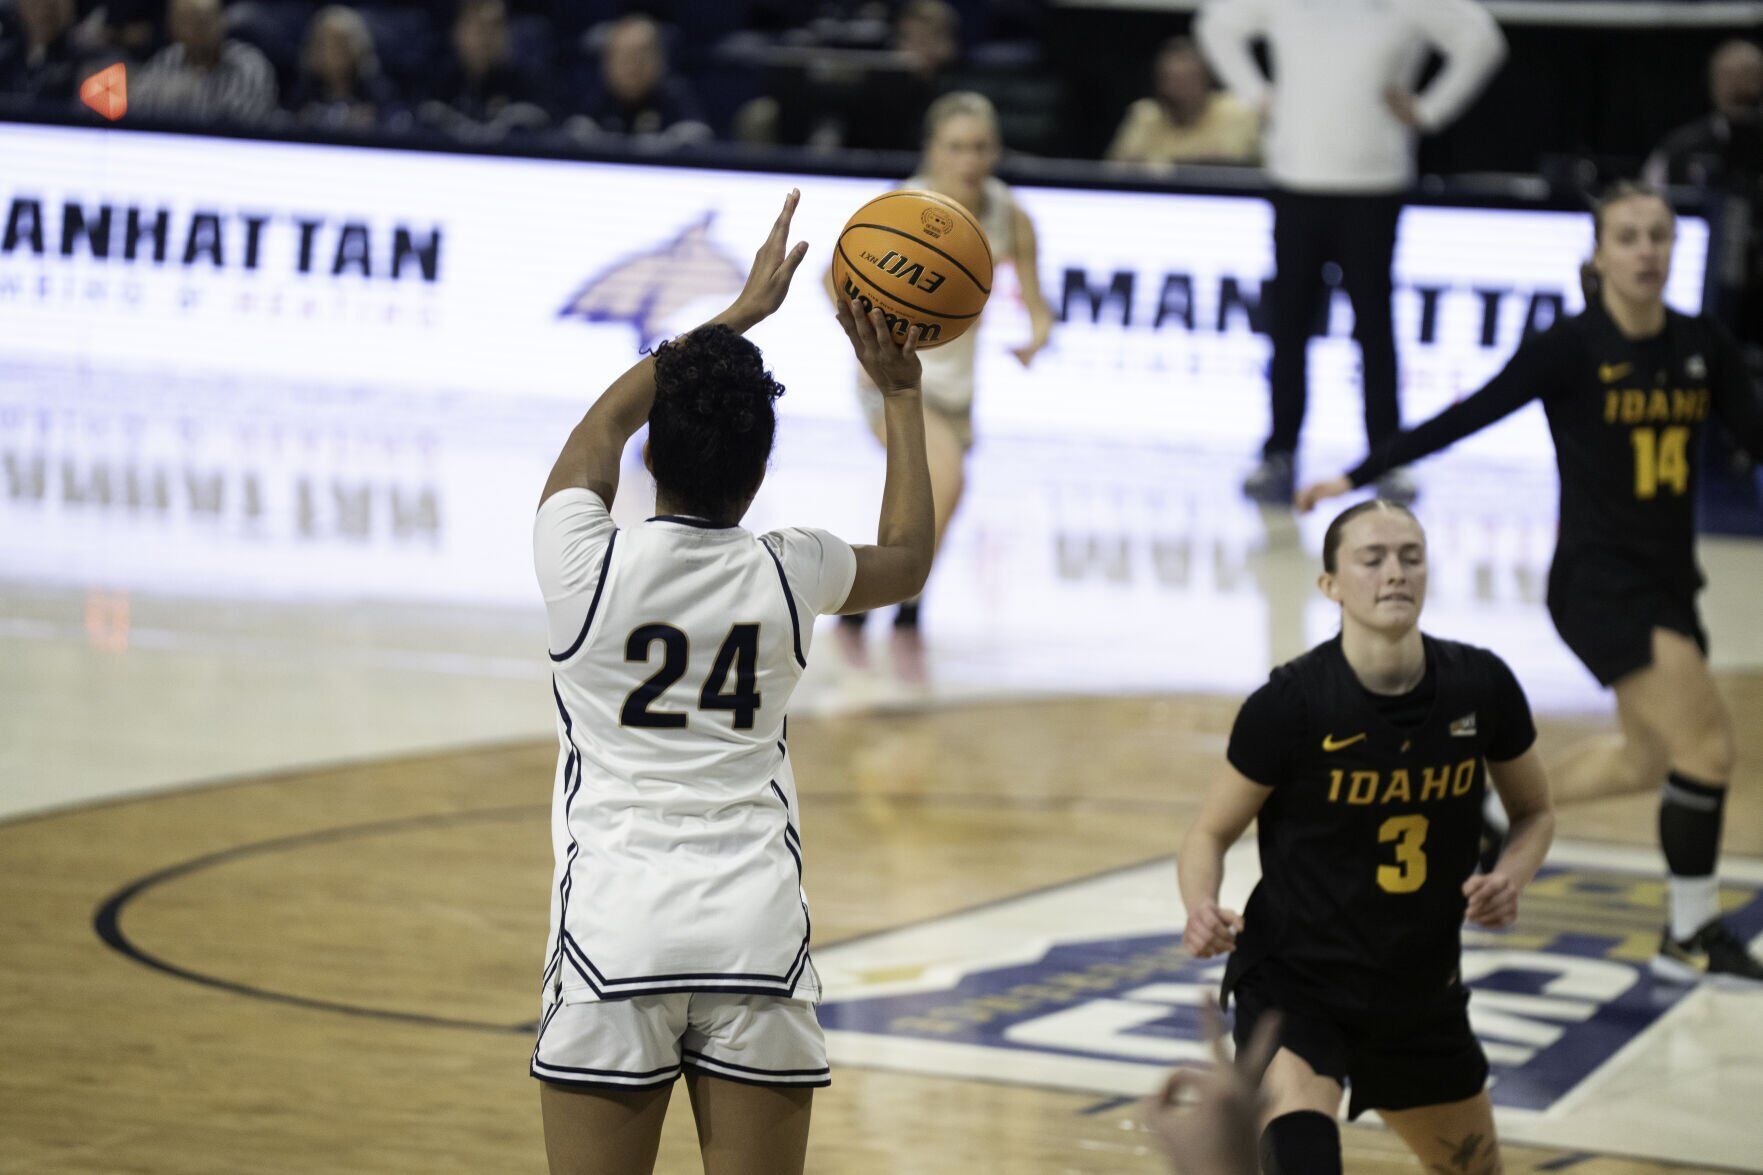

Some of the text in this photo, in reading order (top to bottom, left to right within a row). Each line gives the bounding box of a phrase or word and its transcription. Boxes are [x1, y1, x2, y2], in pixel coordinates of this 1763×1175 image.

[859, 250, 946, 294] EVO NXT
[1630, 427, 1690, 499] 14
[618, 621, 761, 730] 24
[1328, 759, 1476, 804] IDAHO
[1376, 813, 1430, 894] 3
